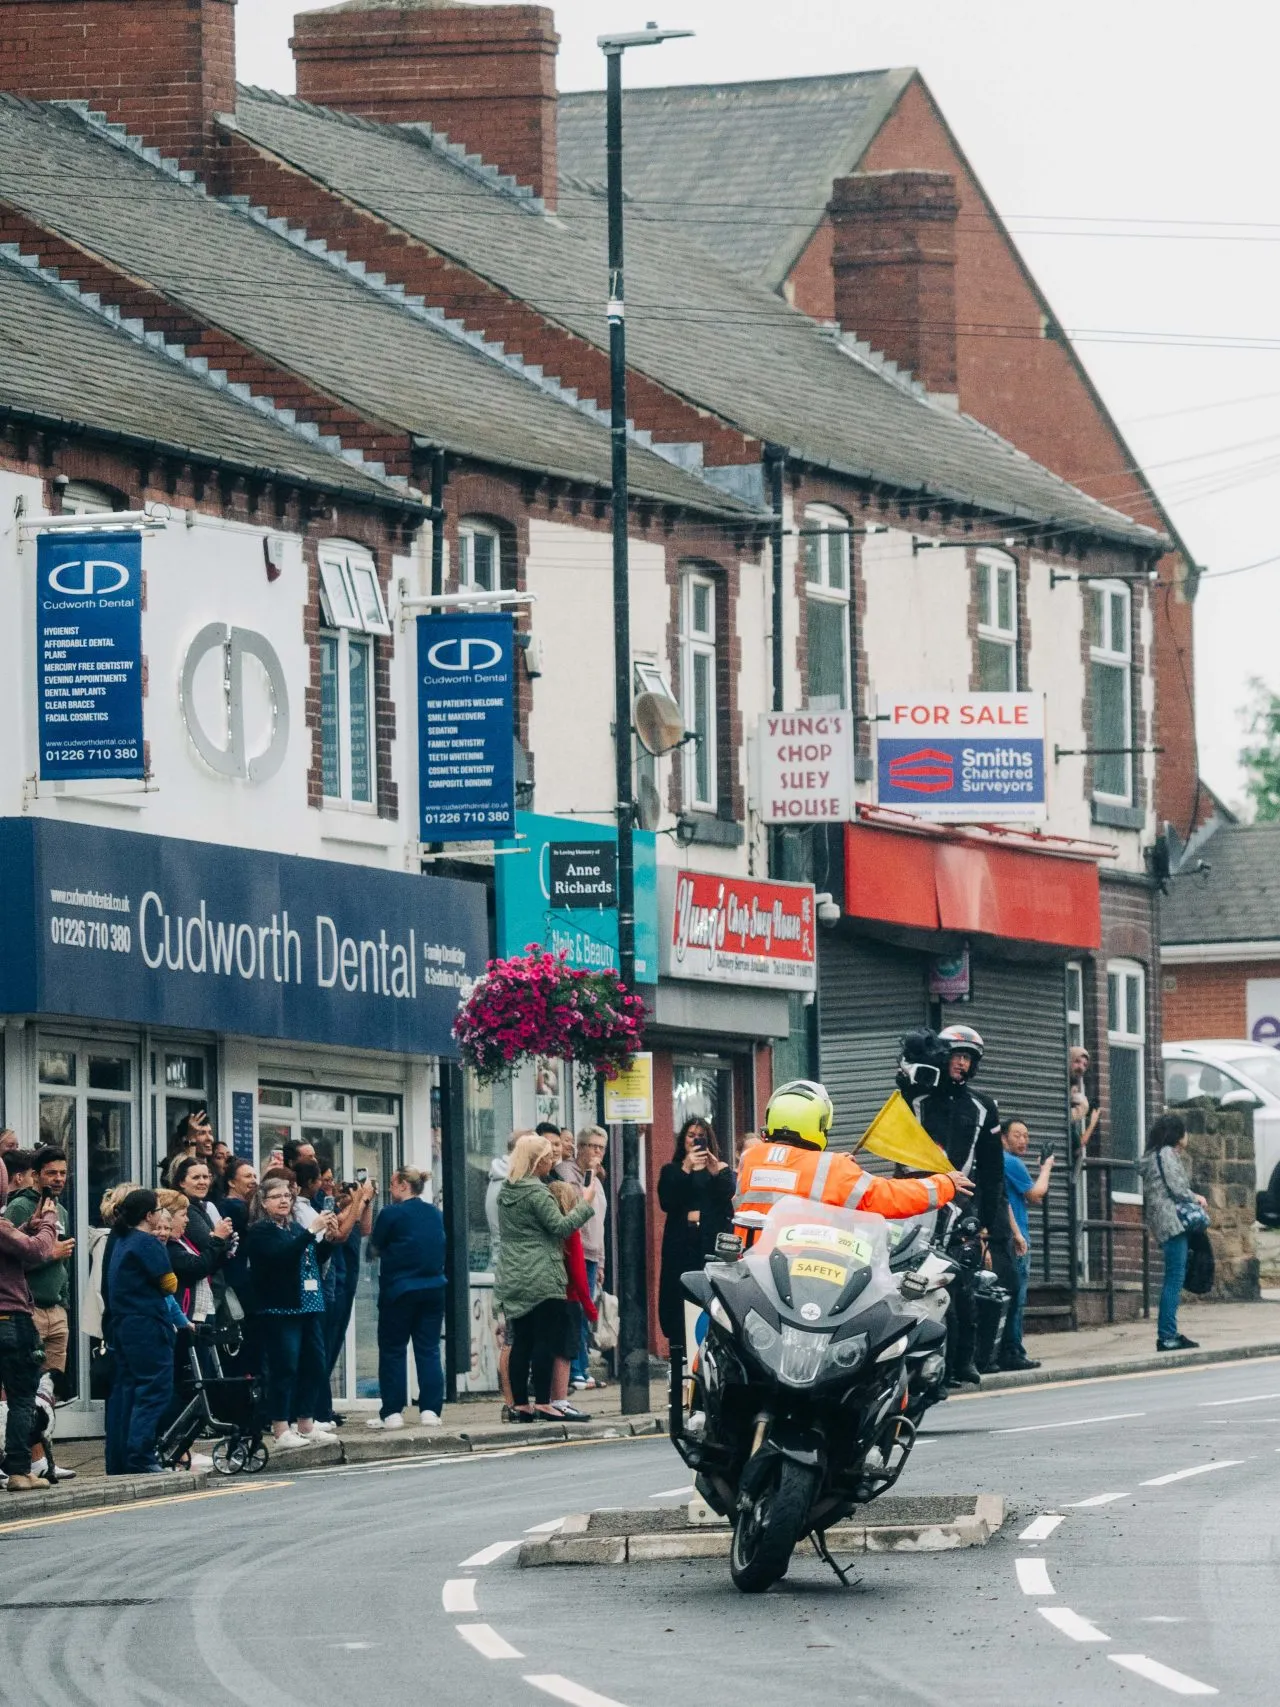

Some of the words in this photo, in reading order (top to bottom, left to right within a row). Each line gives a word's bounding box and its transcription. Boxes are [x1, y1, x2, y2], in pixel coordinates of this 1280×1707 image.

[43, 600, 96, 610] Cudworth
[99, 598, 135, 608] Dental
[44, 626, 80, 636] HYGIENIST
[44, 639, 88, 648] AFFORDABLE
[88, 638, 115, 648] DENTAL
[44, 650, 66, 659] PLANS
[44, 663, 77, 672] MERCURY
[78, 662, 95, 671] FREE
[96, 661, 134, 670] DENTISTRY
[44, 676, 73, 684] EVENING
[75, 674, 127, 683] APPOINTMENTS
[424, 675, 472, 685] Cudworth
[474, 674, 508, 682] Dental
[44, 688, 70, 697] DENTAL
[72, 688, 107, 696] IMPLANTS
[45, 701, 67, 710] CLEAR
[68, 700, 95, 709] BRACES
[427, 700, 442, 709] NEW
[443, 699, 472, 708] PATIENTS
[473, 698, 504, 707] WELCOME
[45, 714, 69, 722] FACIAL
[70, 713, 109, 722] COSMETICS
[427, 713, 446, 722] SMILE
[448, 712, 486, 721] MAKEOVERS
[894, 705, 949, 725] FOR
[960, 705, 1029, 725] SALE
[428, 727, 458, 735] SEDATION
[768, 717, 842, 736] YUNG'S
[46, 738, 137, 747] www.cudworthdental.co.uk
[428, 740, 450, 748] FAMILY
[452, 739, 486, 747] DENTISTRY
[46, 750, 85, 761] 01226
[88, 749, 111, 760] 710
[114, 748, 138, 759] 380
[428, 753, 448, 762] TEETH
[449, 752, 484, 760] WHITENING
[777, 744, 832, 762] CHOP
[962, 748, 1032, 767] Smiths
[428, 766, 460, 775] COSMETIC
[461, 765, 494, 774] DENTISTRY
[962, 767, 1033, 779] Chartered
[428, 779, 464, 788] COMPOSITE
[464, 779, 492, 787] BONDING
[780, 771, 830, 789] SUEY
[962, 779, 1033, 794] Surveyors
[772, 798, 840, 817] HOUSE
[426, 813, 460, 824] 01226
[464, 812, 485, 822] 710
[488, 811, 509, 822] 380
[566, 863, 601, 876] Anne
[555, 881, 612, 894] Richards
[50, 888, 131, 913] www.cudworthdental.co.uk
[676, 877, 726, 971] Yung's
[728, 892, 749, 949] Chop
[750, 896, 773, 951] Suey
[773, 899, 801, 941] House
[51, 916, 86, 948] 01226
[88, 921, 109, 950] 710
[110, 924, 131, 953] 380
[138, 890, 302, 985] Cudworth
[316, 915, 418, 999] Dental
[576, 933, 582, 964] &
[584, 933, 614, 970] Beauty
[796, 1263, 842, 1278] SAFETY
